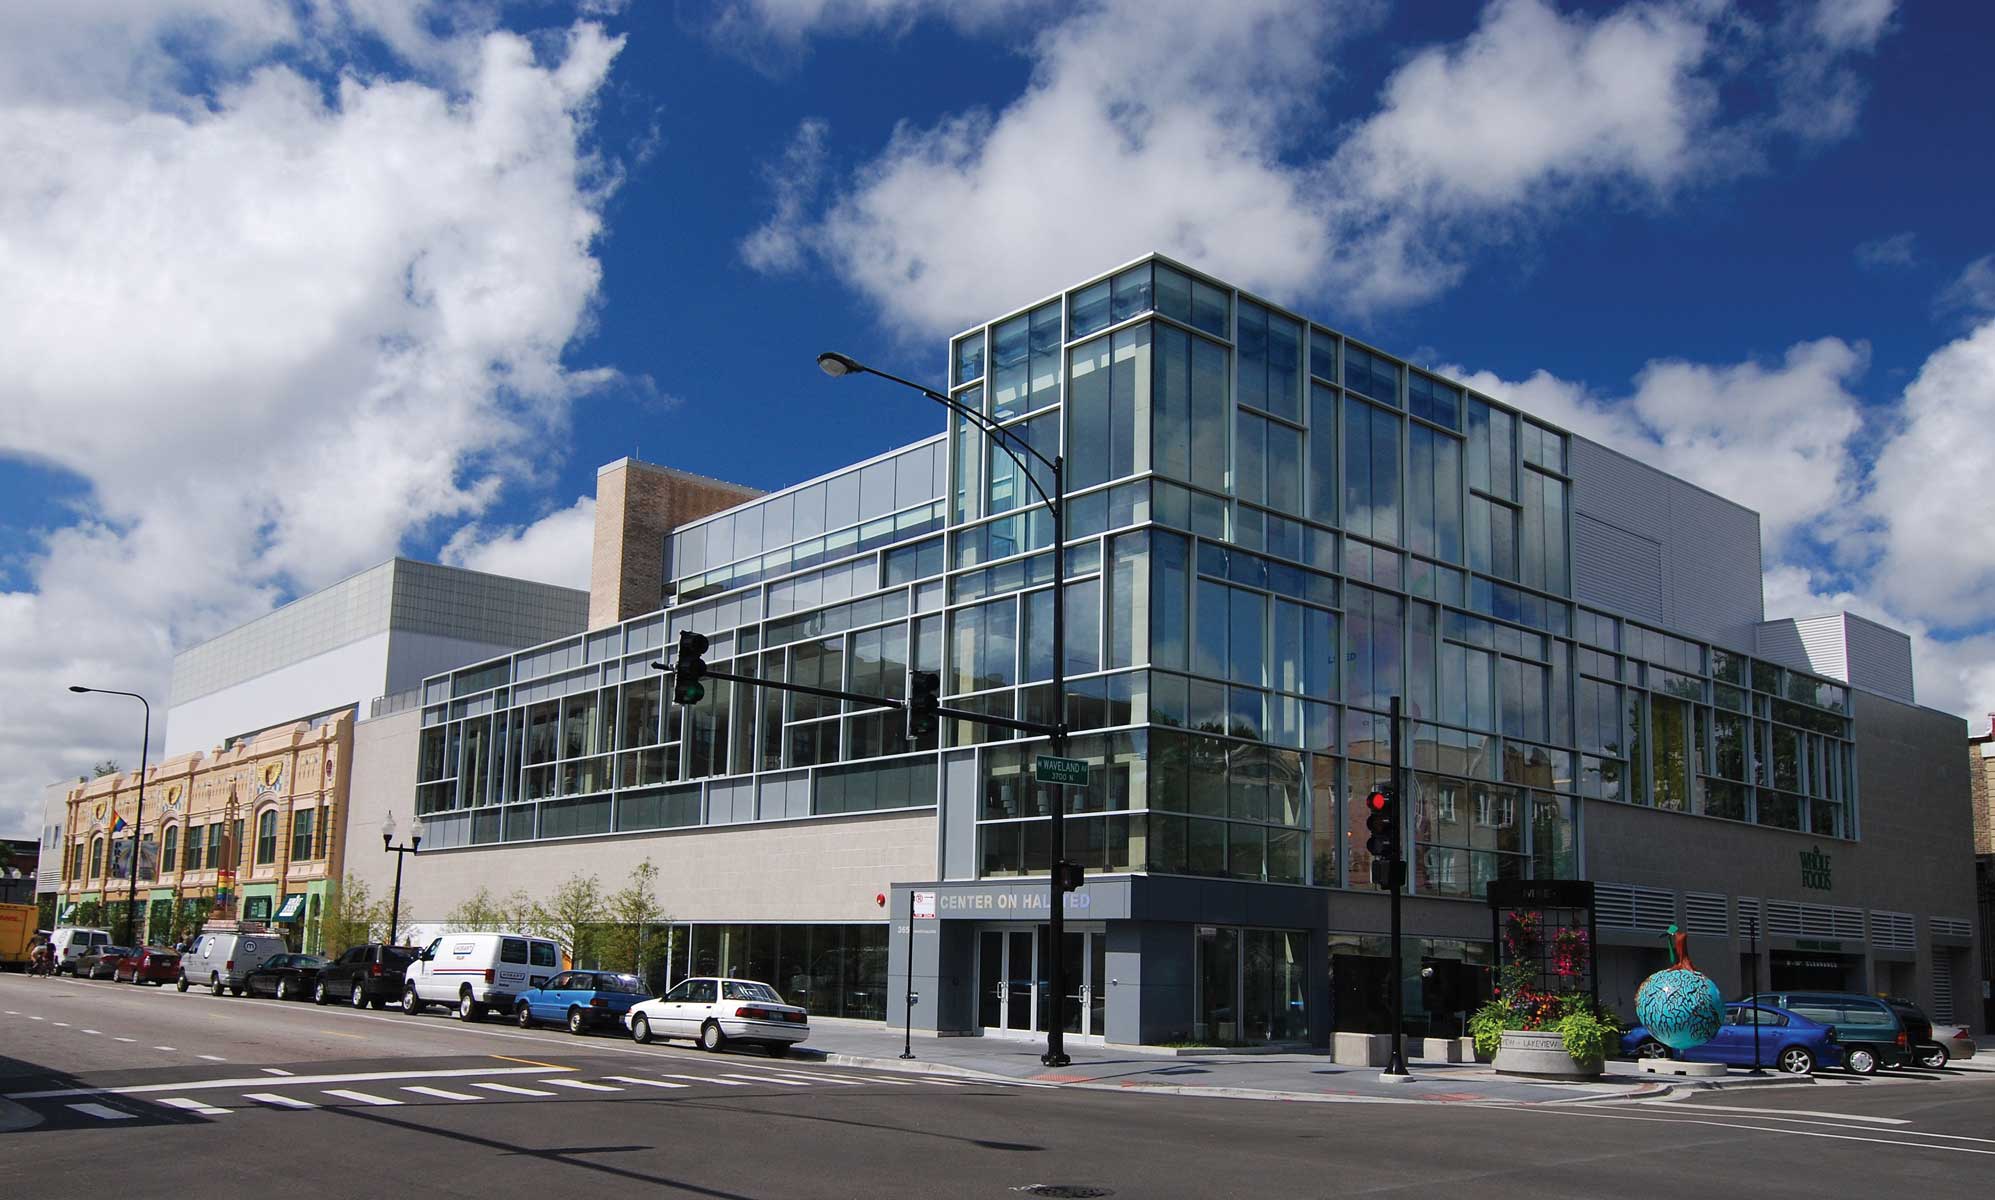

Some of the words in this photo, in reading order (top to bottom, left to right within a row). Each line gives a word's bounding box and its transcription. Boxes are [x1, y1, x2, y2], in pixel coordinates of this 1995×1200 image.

[1043, 759, 1080, 773] WAVELAND
[1051, 772, 1067, 781] 3700
[1799, 851, 1832, 873] WHOLE
[1801, 870, 1832, 891] FOODS
[939, 894, 993, 910] CENTER
[997, 894, 1017, 909] ON
[1022, 893, 1091, 909] HALTED
[1522, 1039, 1558, 1049] LAKEVIEW
